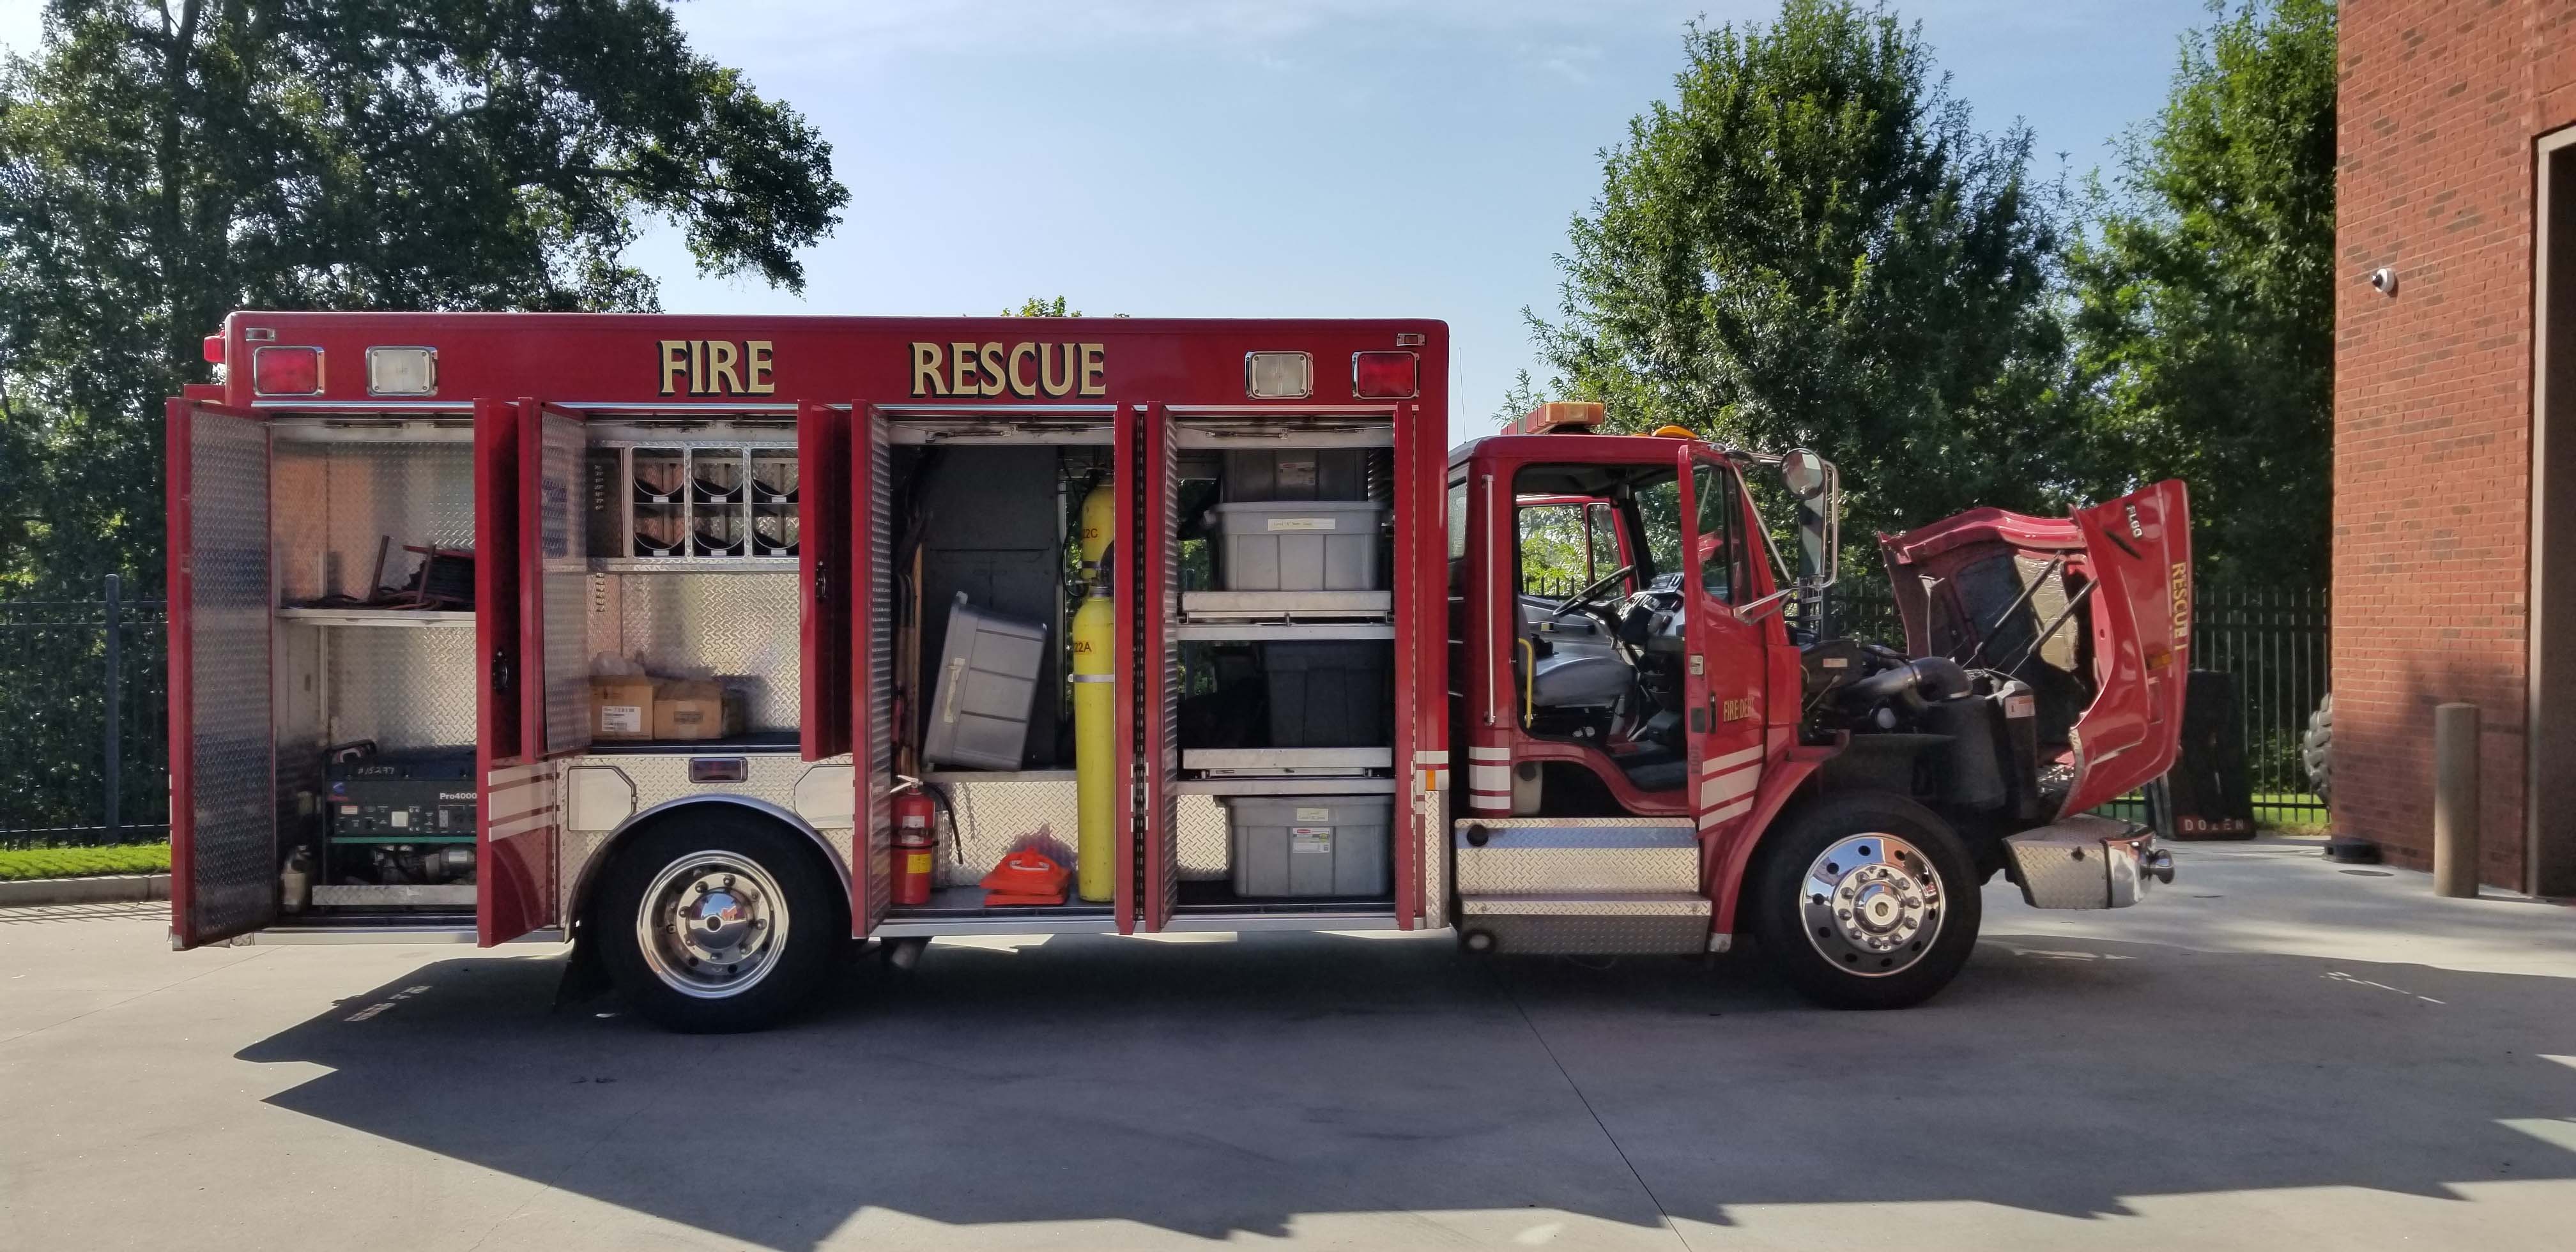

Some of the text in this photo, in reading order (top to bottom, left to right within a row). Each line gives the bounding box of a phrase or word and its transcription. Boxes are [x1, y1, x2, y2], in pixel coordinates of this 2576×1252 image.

[657, 340, 1107, 399] FIRE RESCUE
[2173, 561, 2188, 638] RESCUE
[1724, 700, 1738, 722] FIRE
